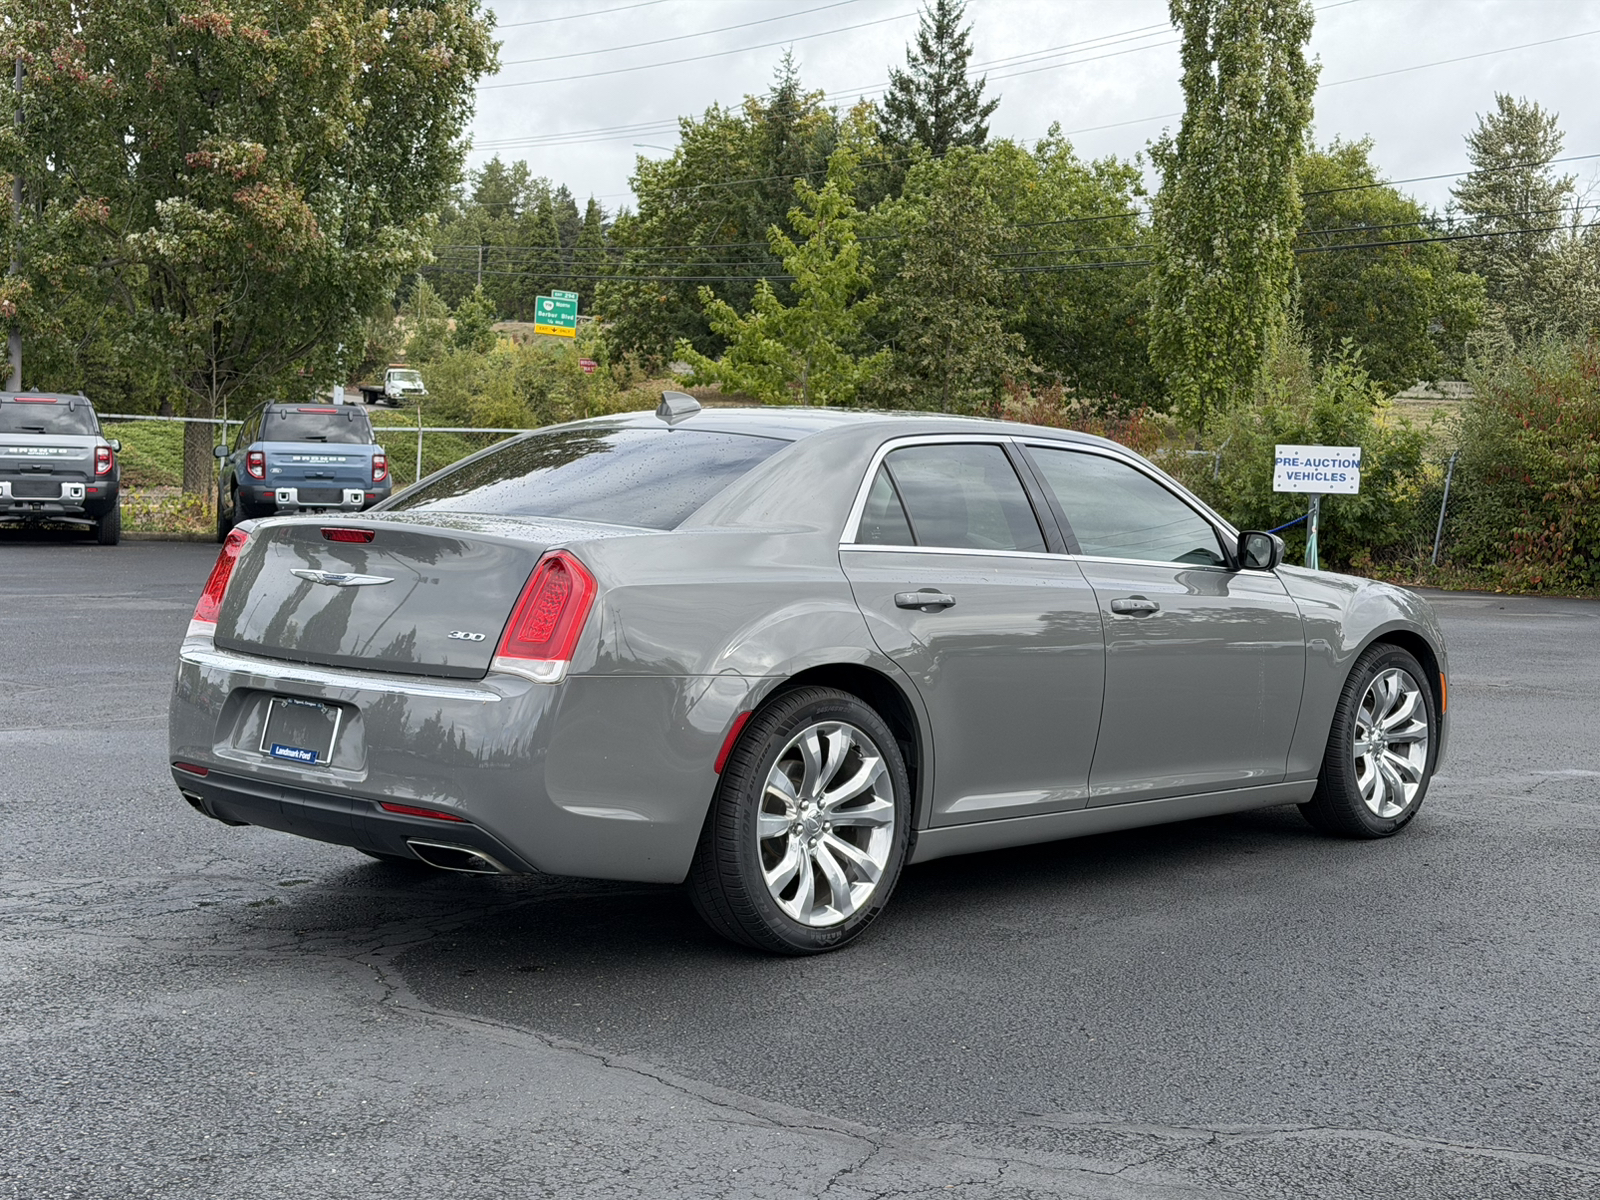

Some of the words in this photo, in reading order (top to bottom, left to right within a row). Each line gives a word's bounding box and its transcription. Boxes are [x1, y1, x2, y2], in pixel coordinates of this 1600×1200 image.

[1275, 457, 1361, 469] PRE-AUCTION
[1286, 471, 1347, 482] VEHICLES
[447, 630, 486, 641] 300
[275, 746, 299, 758] Landmark
[299, 750, 312, 760] Ford
